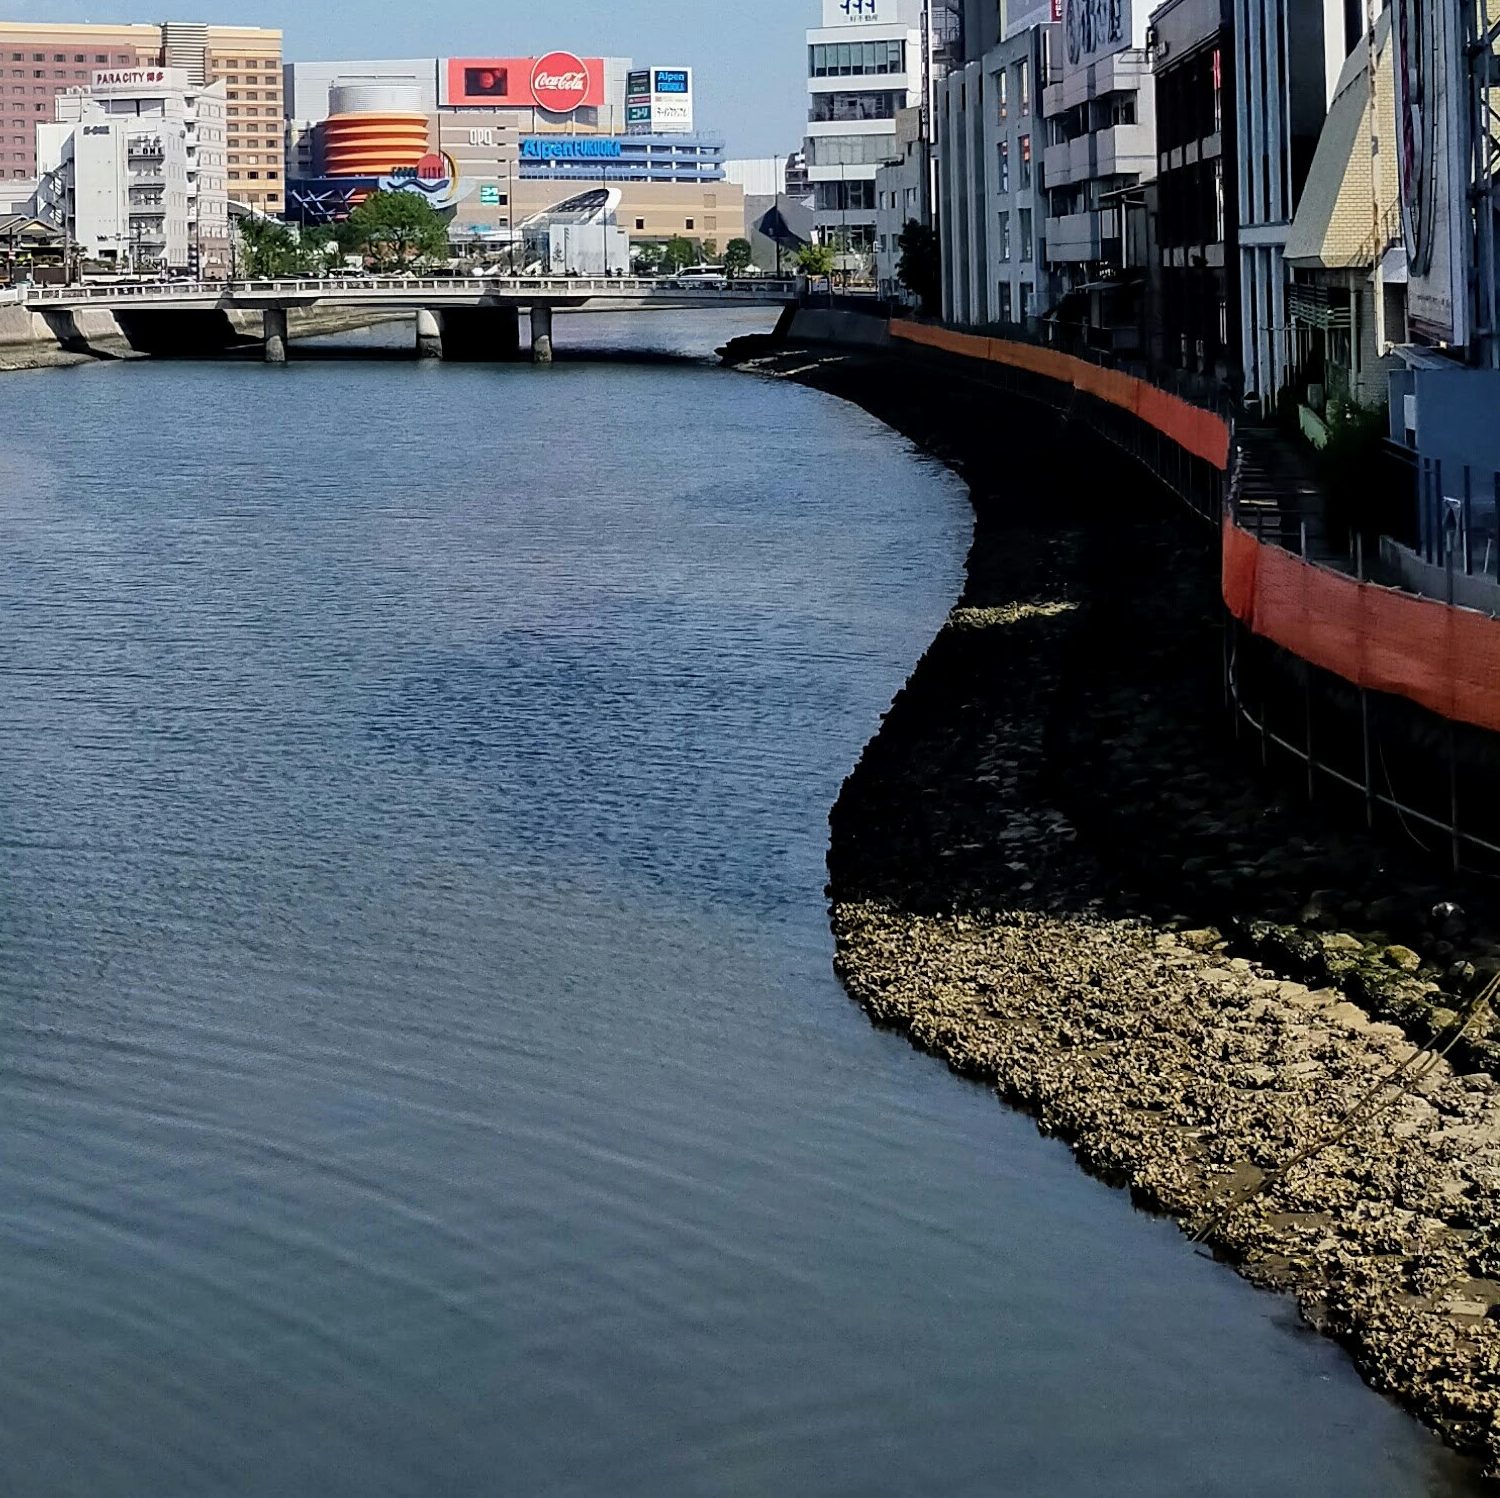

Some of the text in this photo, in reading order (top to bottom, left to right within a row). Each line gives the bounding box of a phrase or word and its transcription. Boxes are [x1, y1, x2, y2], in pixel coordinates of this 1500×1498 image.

[657, 71, 685, 82] Alpen
[522, 139, 621, 160] Alpen FUKUOKA
